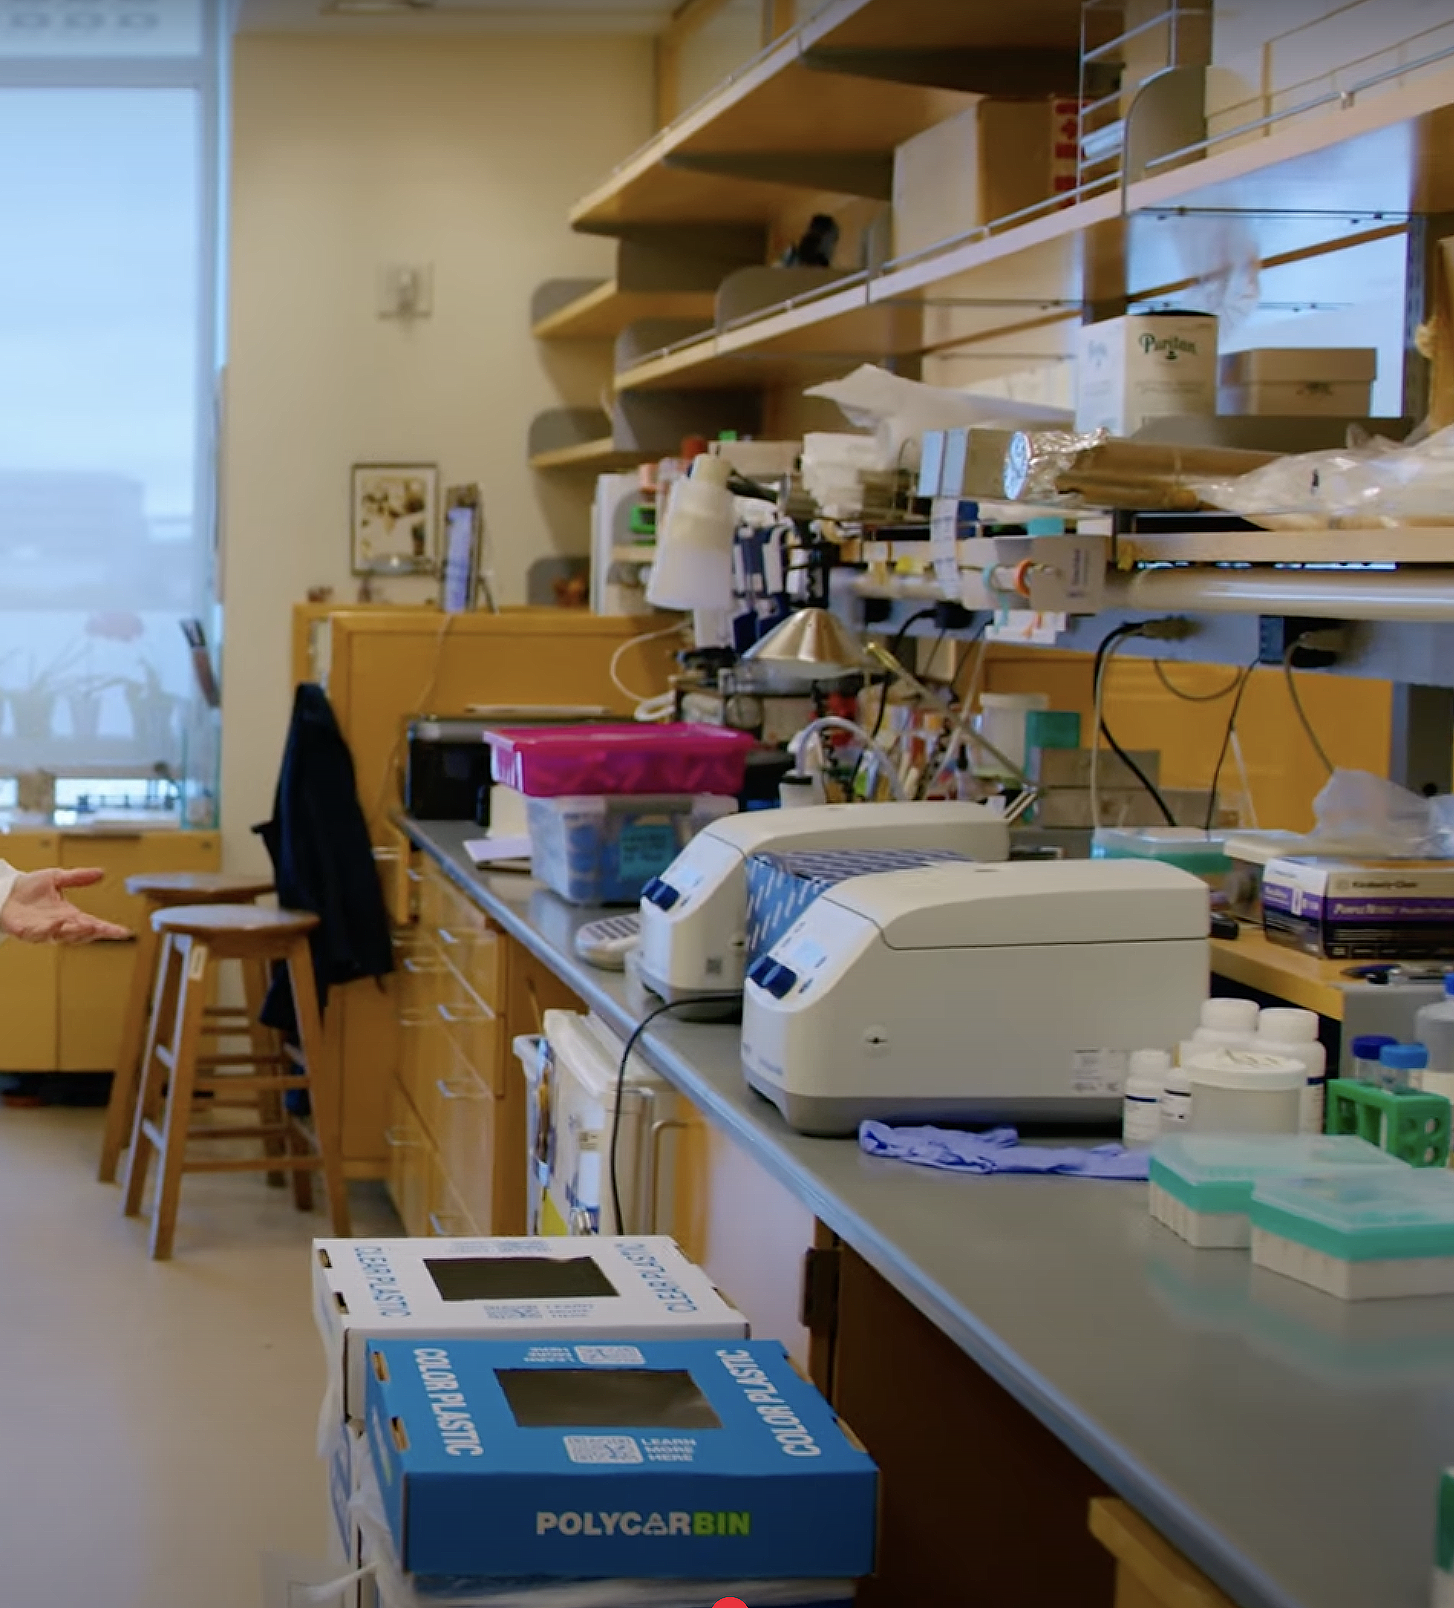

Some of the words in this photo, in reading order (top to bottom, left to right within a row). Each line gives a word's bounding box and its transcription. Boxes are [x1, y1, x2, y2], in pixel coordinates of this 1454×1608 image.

[1139, 333, 1198, 355] Puritan
[413, 1348, 459, 1391] COLOR
[716, 1349, 786, 1403] PLASTIC
[428, 1392, 484, 1456] PLASTIC
[756, 1405, 821, 1457] COLOR
[536, 1511, 750, 1536] POLYCARBIN
